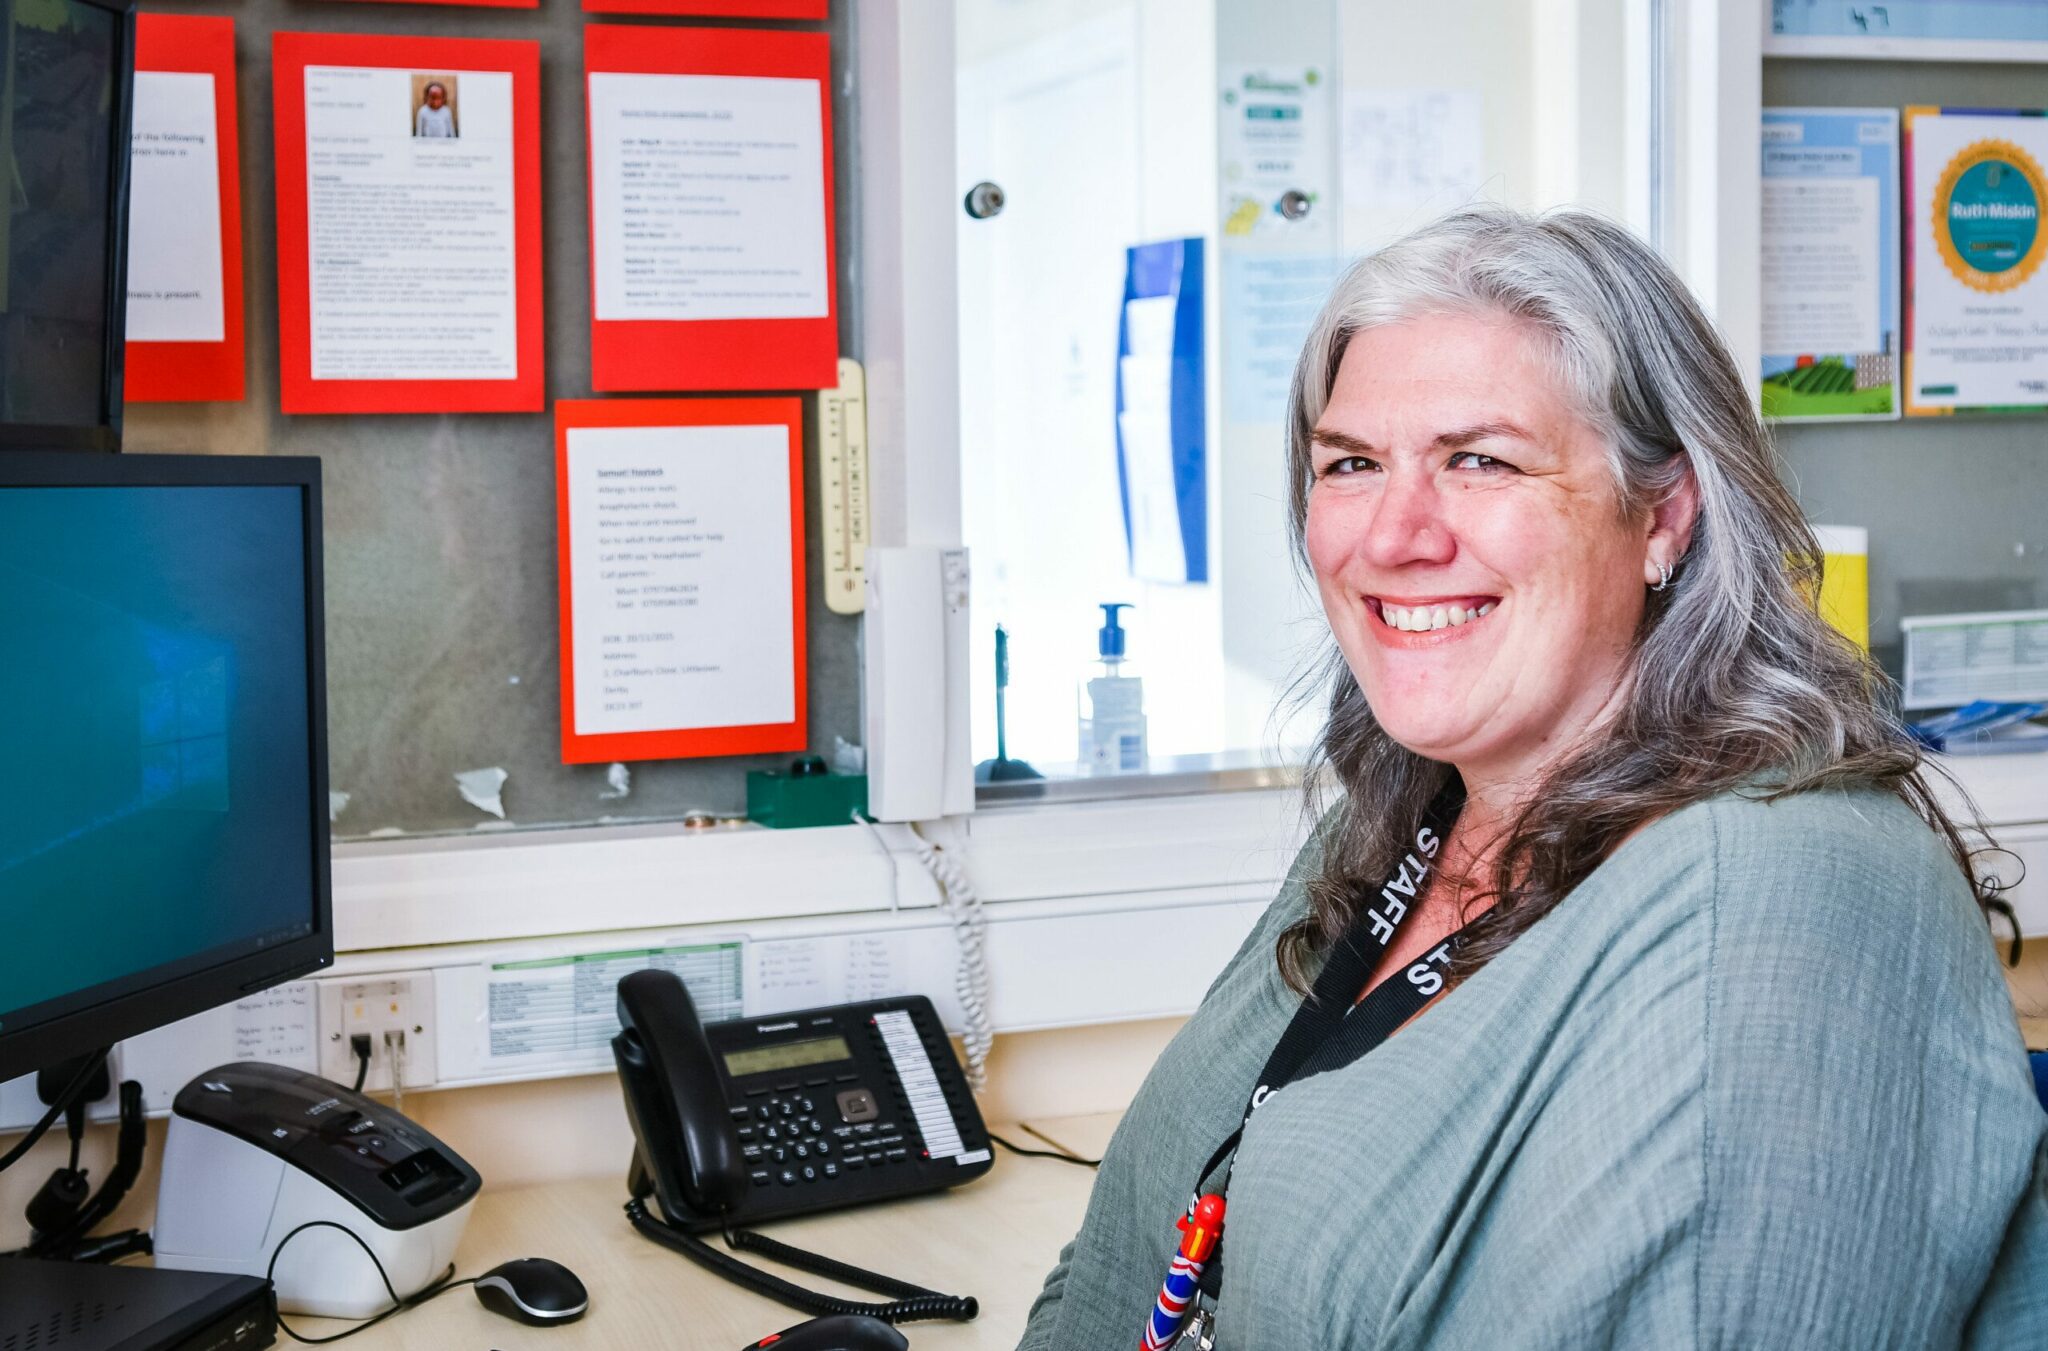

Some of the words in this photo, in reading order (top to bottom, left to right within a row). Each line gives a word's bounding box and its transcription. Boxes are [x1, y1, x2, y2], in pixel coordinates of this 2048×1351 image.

[163, 134, 205, 145] following
[1951, 201, 1986, 218] Ruth
[1989, 202, 2037, 219] Miskin
[1368, 827, 1439, 945] STAFF
